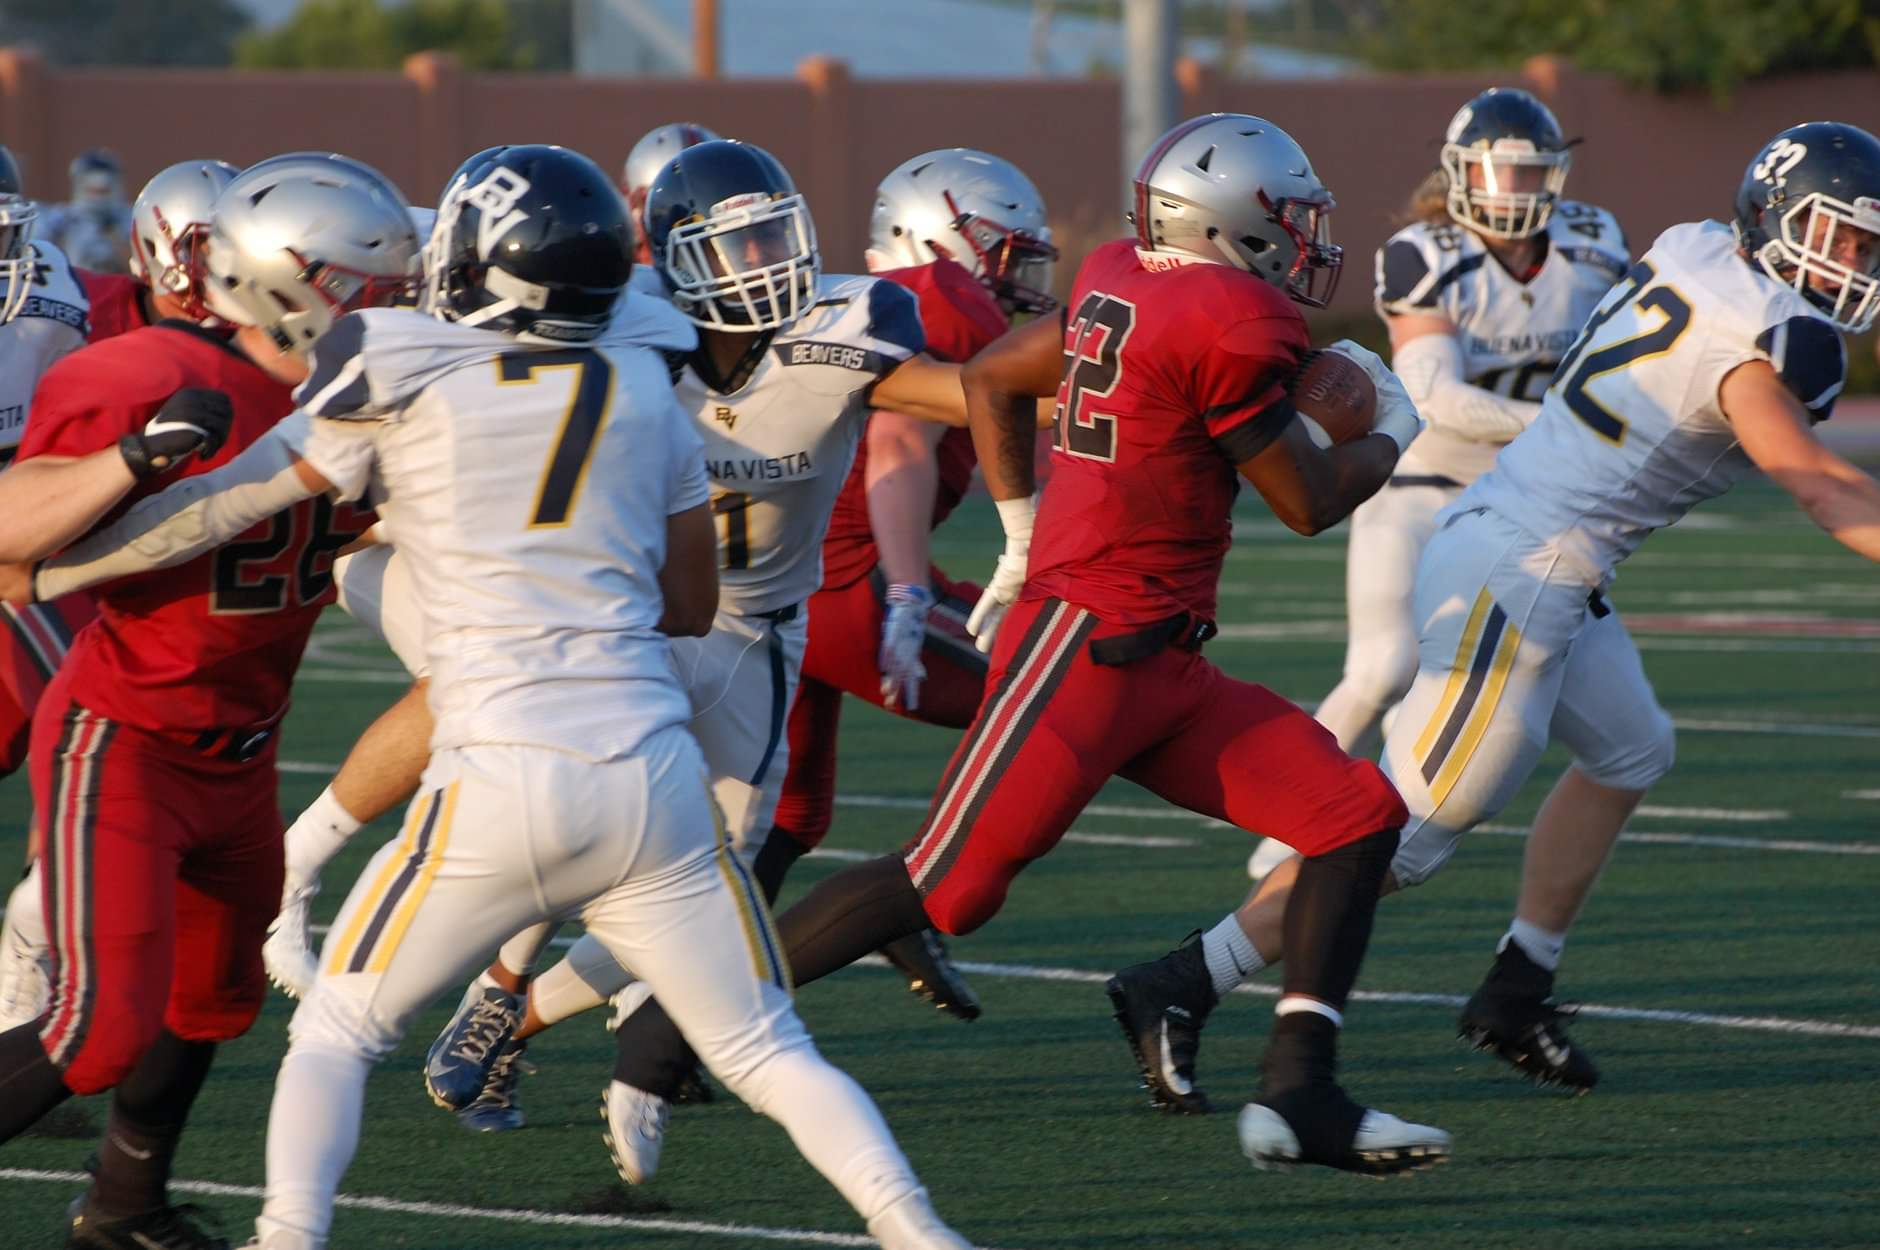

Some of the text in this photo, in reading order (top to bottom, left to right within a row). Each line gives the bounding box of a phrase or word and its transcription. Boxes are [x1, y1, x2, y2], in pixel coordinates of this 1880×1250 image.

[791, 343, 866, 369] BEAVERS
[1052, 290, 1136, 463] 22
[494, 346, 616, 530] 7
[741, 451, 812, 480] VISTA
